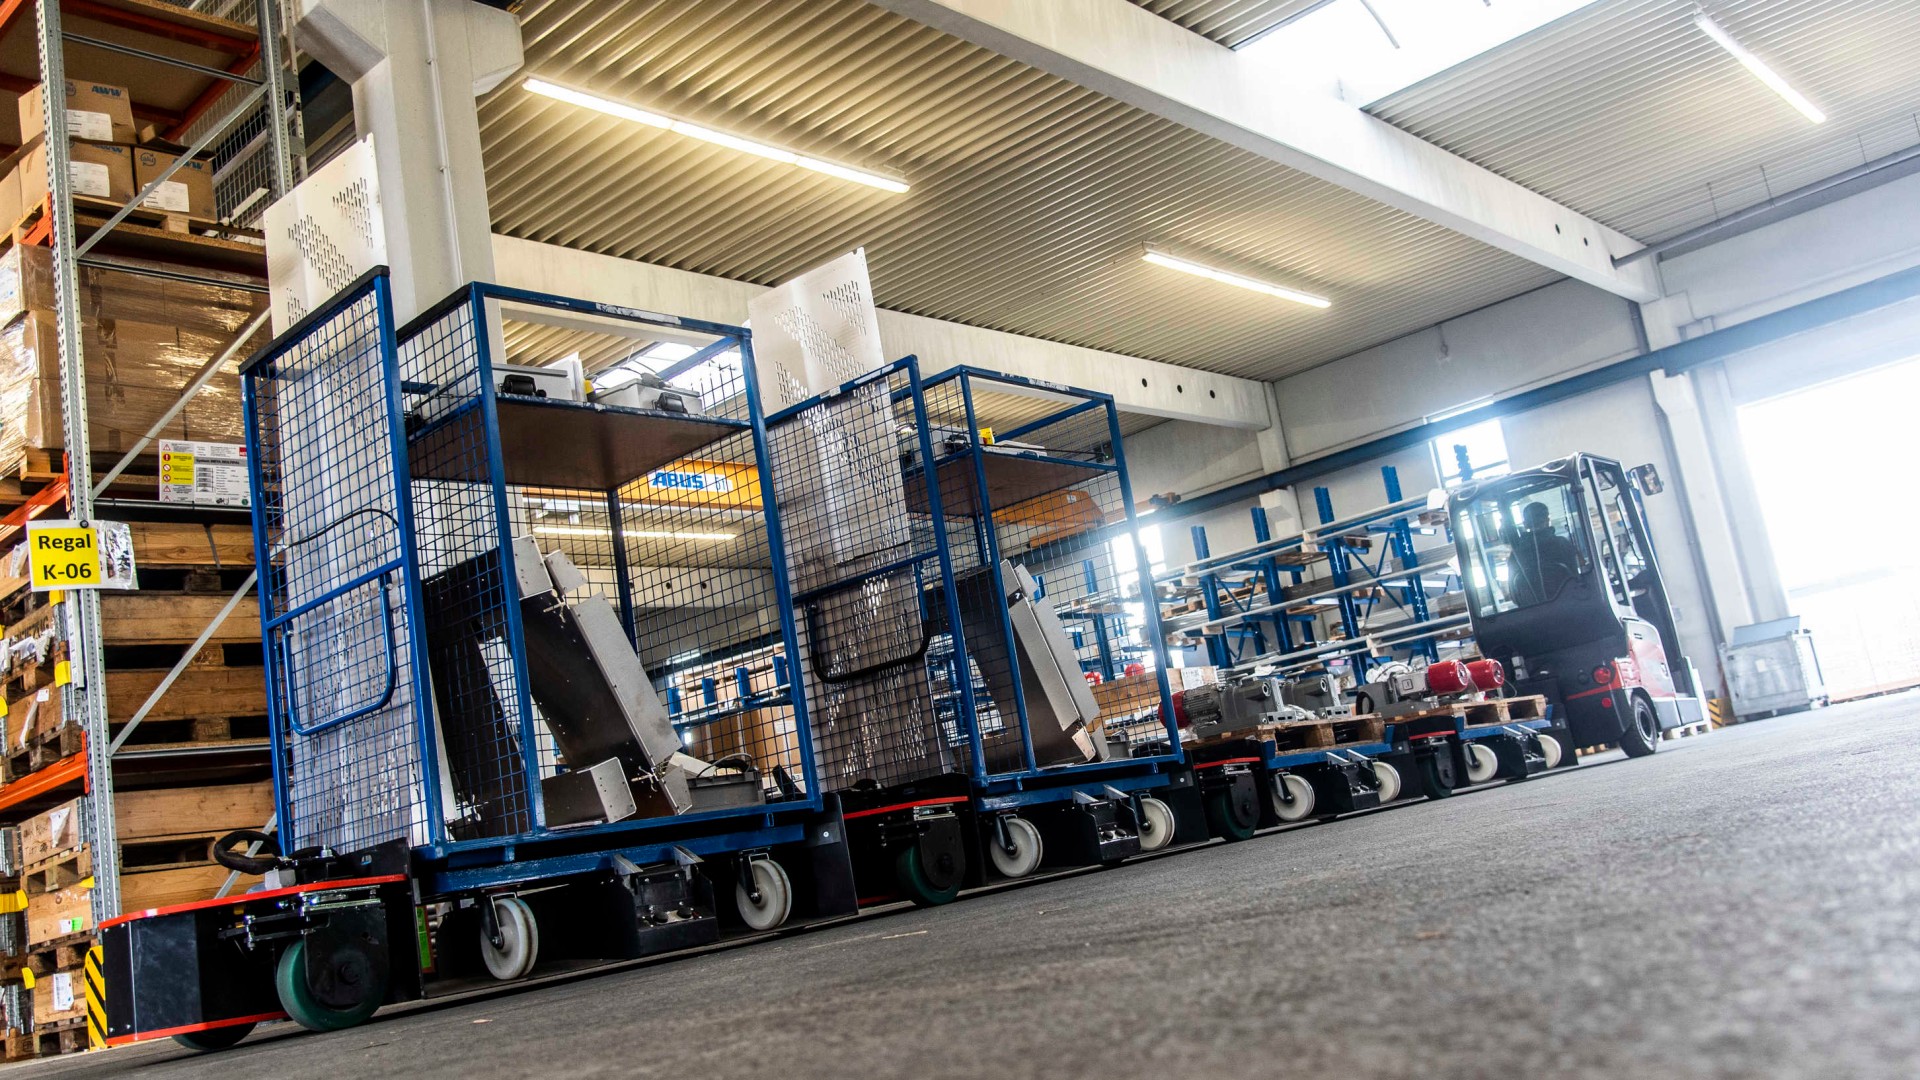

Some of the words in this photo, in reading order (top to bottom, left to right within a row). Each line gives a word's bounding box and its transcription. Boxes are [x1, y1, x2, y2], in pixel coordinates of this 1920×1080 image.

[652, 472, 704, 490] ABUS
[38, 534, 91, 552] Regal
[43, 563, 92, 580] K-06
